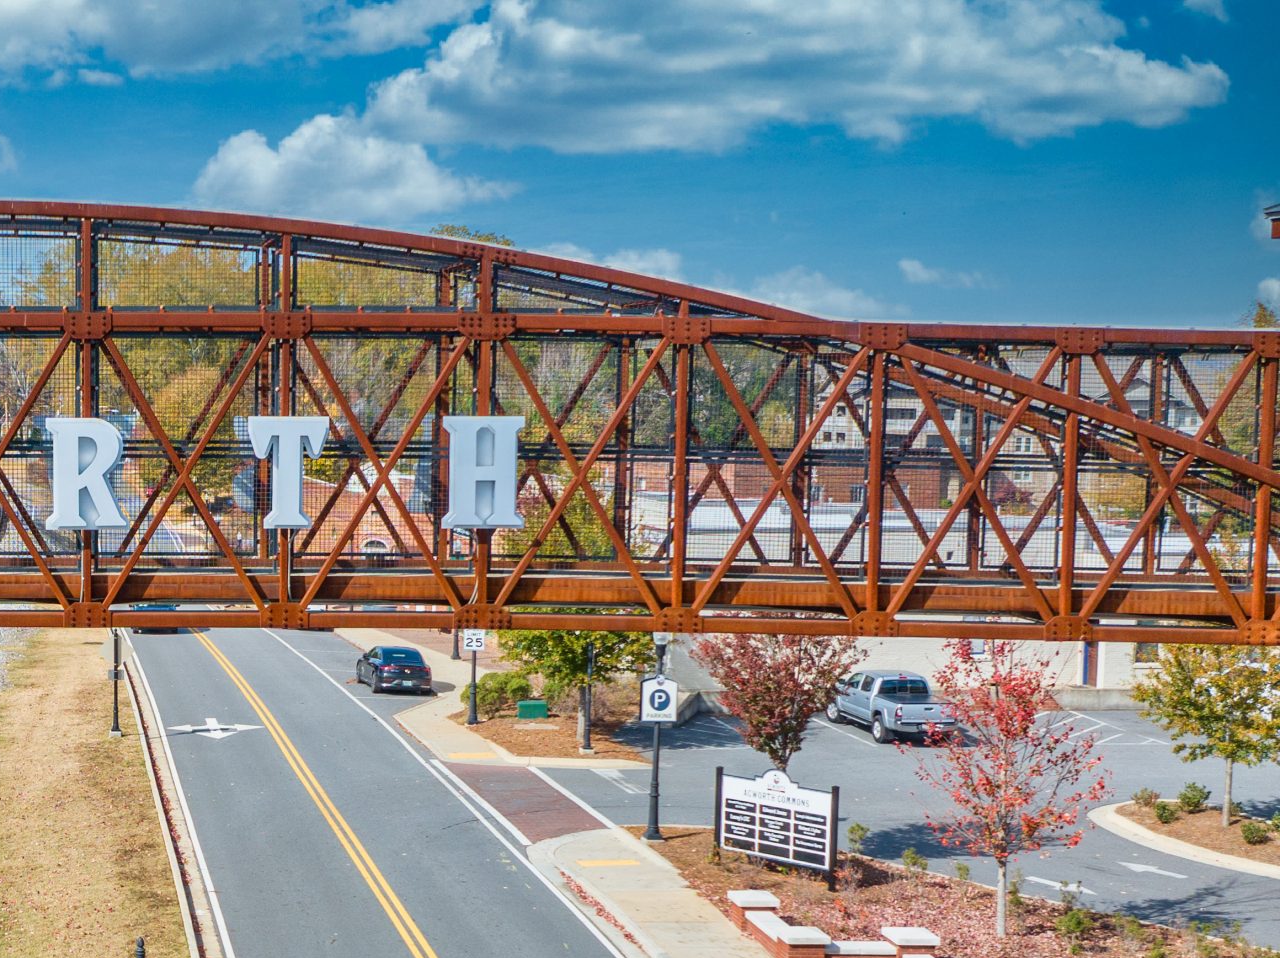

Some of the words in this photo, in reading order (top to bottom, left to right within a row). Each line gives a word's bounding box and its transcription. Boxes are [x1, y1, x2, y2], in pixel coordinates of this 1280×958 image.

[465, 637, 483, 648] 25
[654, 692, 667, 708] P
[743, 789, 776, 802] ACWORTH
[777, 795, 810, 807] COMMONS
